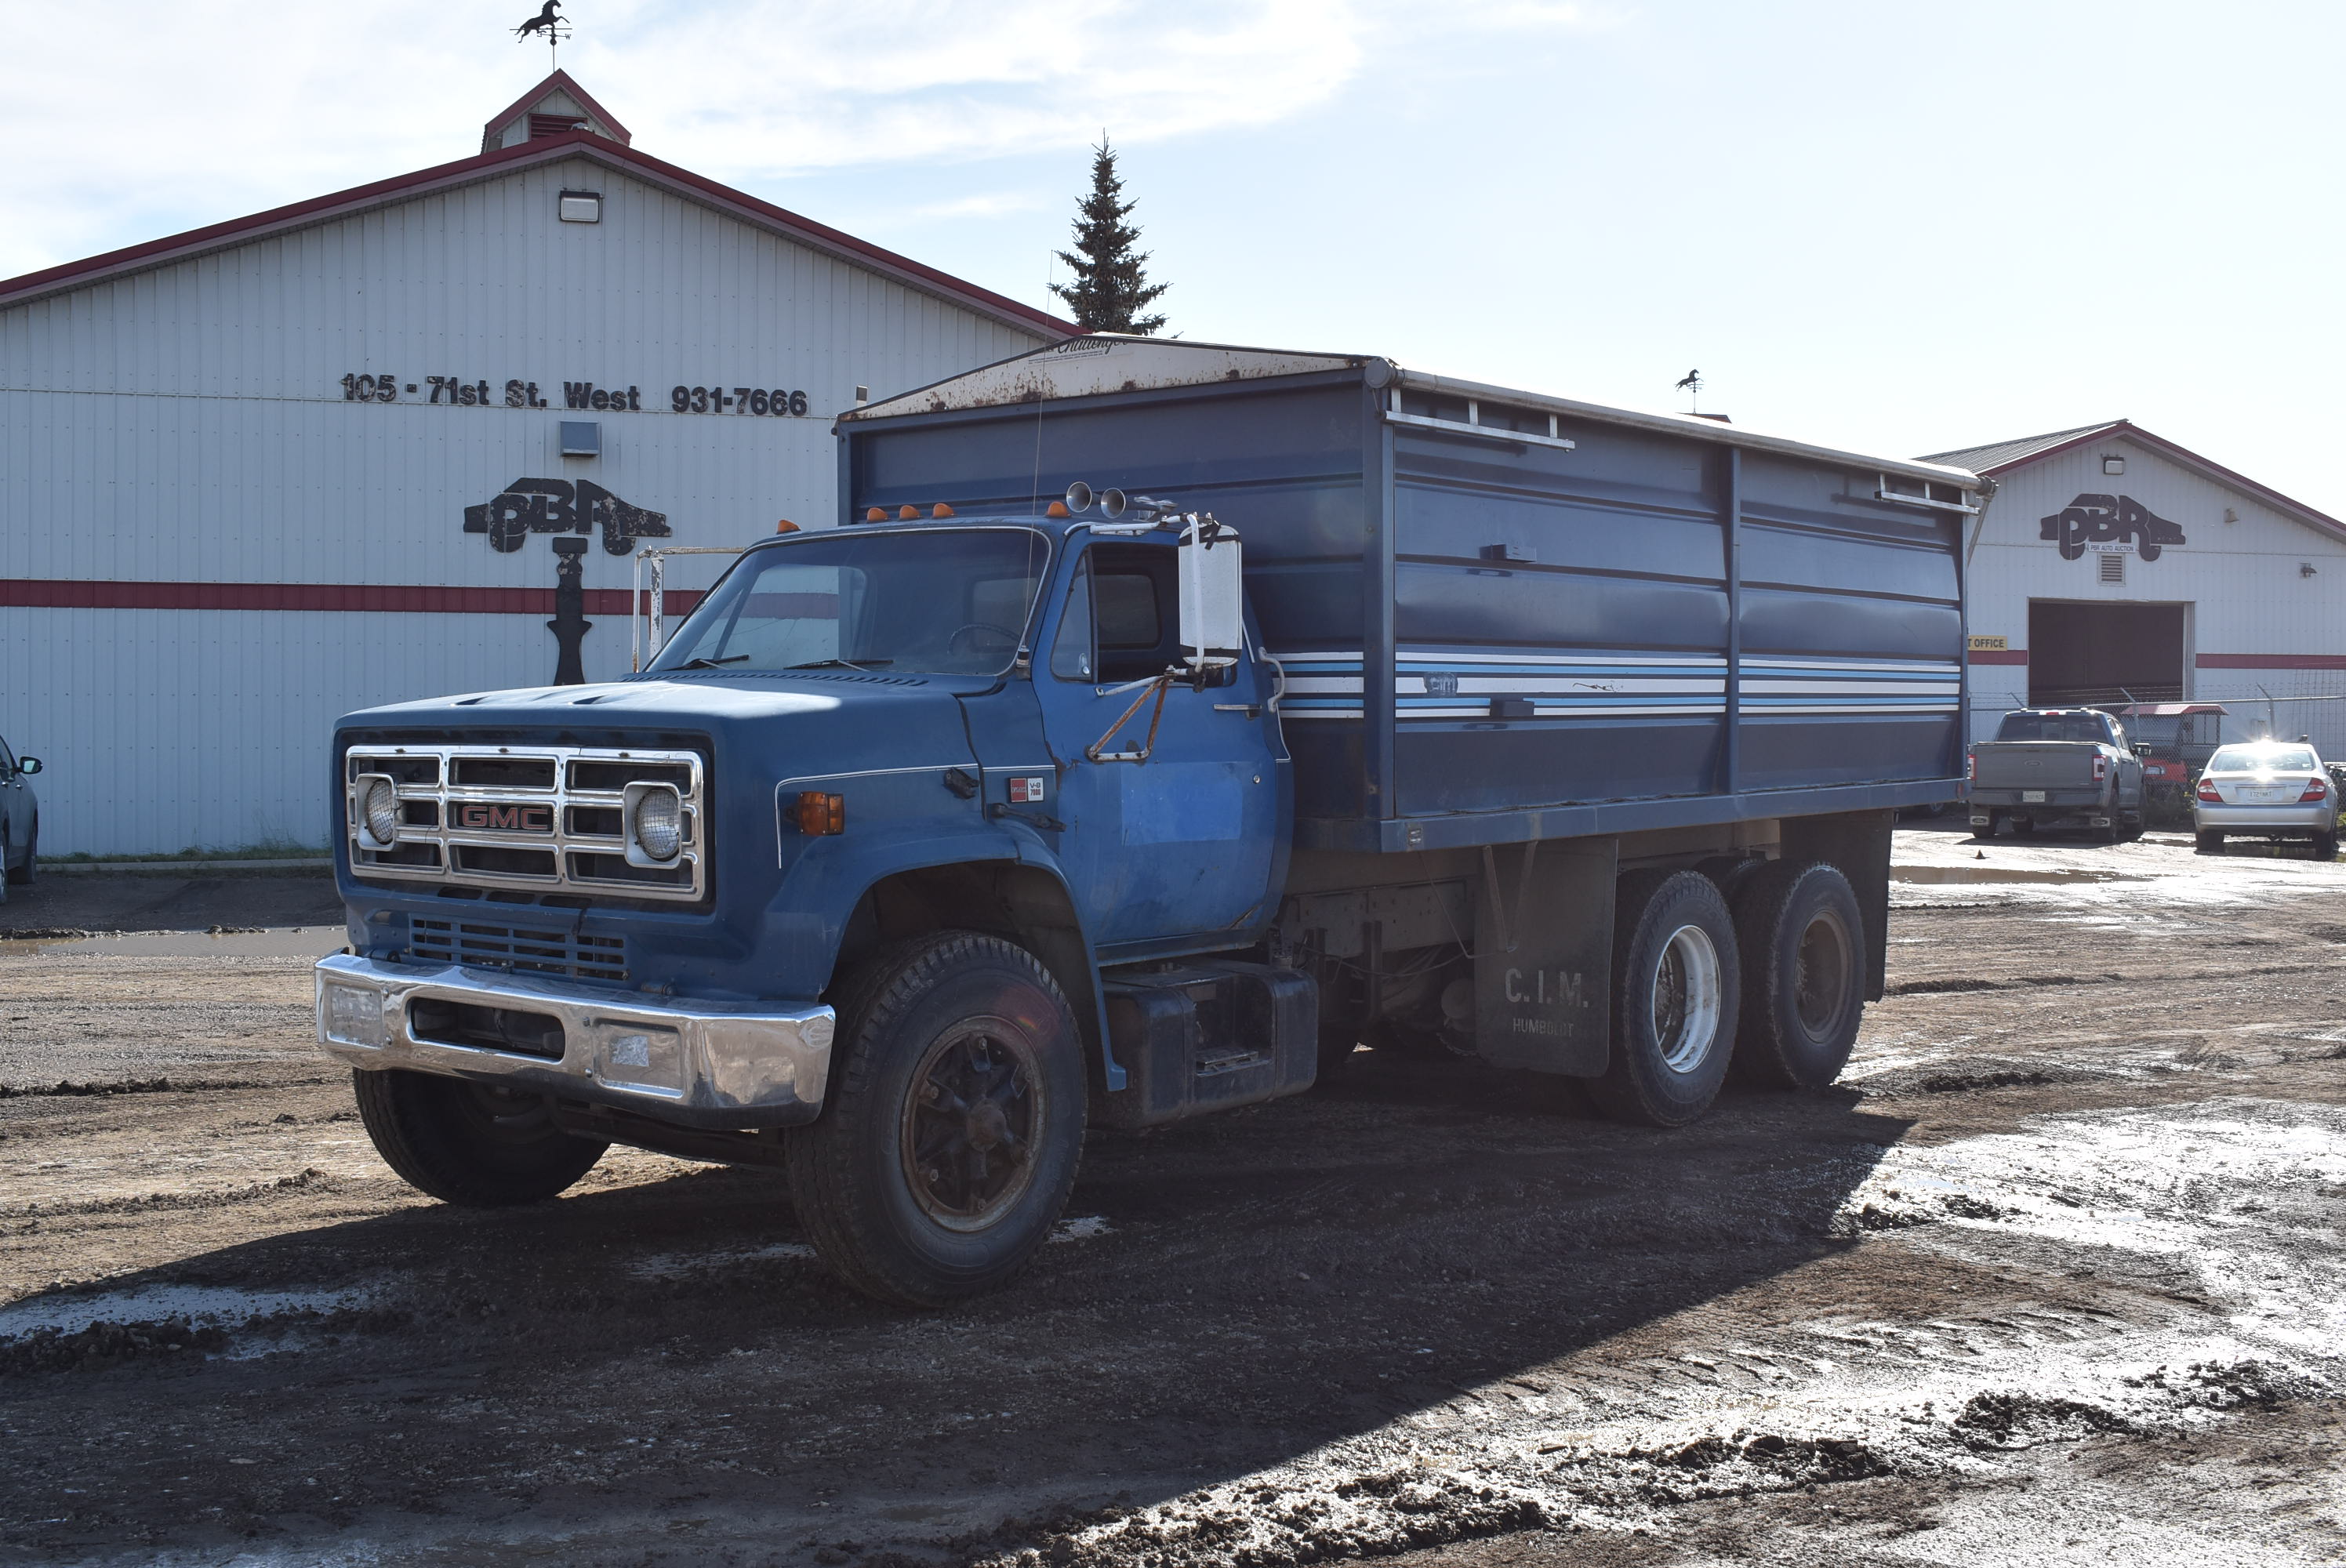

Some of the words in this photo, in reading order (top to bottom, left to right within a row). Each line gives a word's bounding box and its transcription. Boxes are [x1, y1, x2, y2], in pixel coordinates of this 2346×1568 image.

[1057, 338, 1129, 355] Challeng
[341, 372, 397, 402] 105
[427, 376, 490, 405] 71st
[506, 379, 547, 408] St.
[563, 381, 641, 411] West
[671, 385, 808, 416] 931-7666
[1974, 638, 2004, 648] OFFICE
[462, 805, 548, 830] GMC
